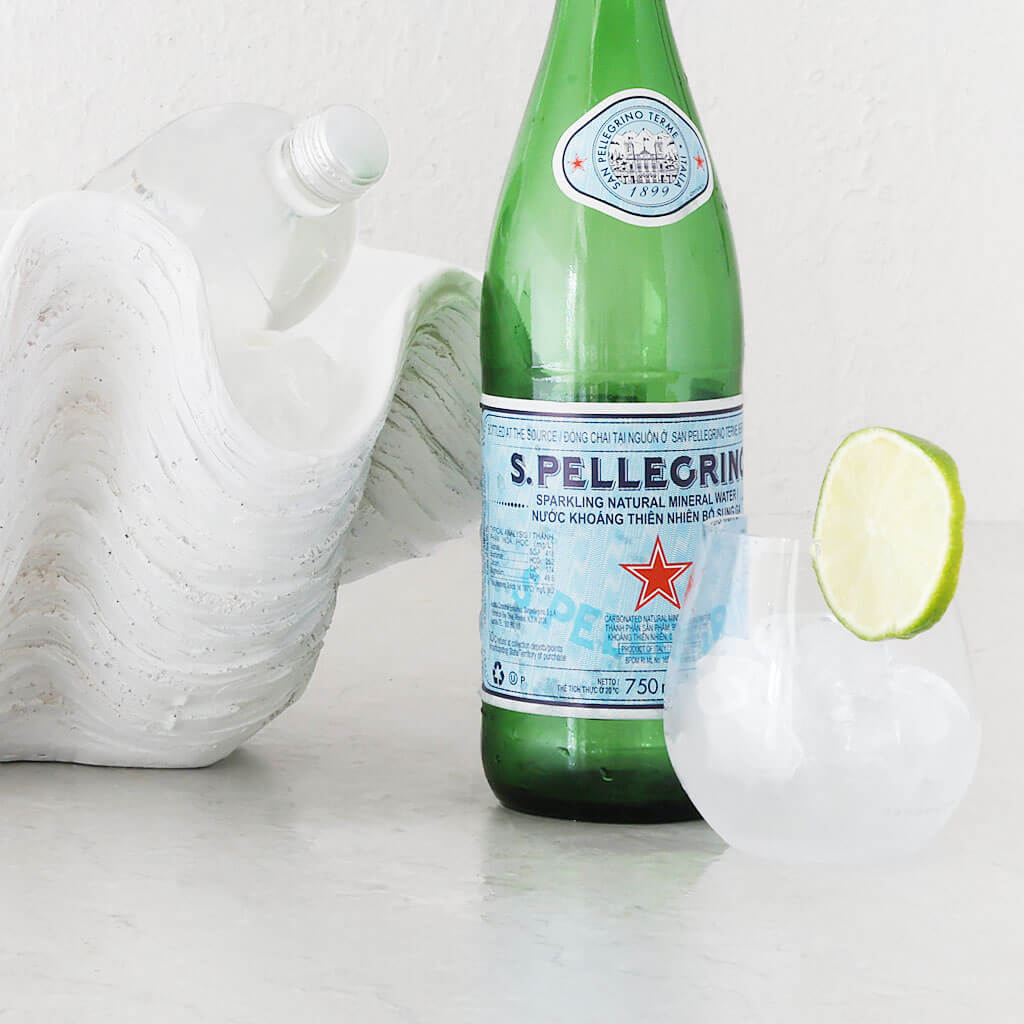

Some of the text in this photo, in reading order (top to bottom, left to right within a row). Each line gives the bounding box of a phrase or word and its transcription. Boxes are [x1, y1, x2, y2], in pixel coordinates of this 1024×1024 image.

[598, 110, 688, 190] SAN PELLEGRINO TERME ITALIA
[630, 185, 670, 197] 1899
[527, 428, 557, 443] SOURCE
[672, 431, 687, 444] SAN
[688, 427, 725, 442] PELLEGRINO
[536, 494, 604, 508] SPARKLING
[608, 496, 665, 509] NATURAL
[668, 493, 713, 508] MINERAL
[714, 489, 736, 504] WATER
[532, 508, 565, 523] NƯỚC
[569, 510, 624, 525] KHOÁNG
[627, 511, 663, 525] THIÊN
[667, 509, 699, 524] NHIÊN
[605, 614, 642, 624] CARBONATED
[643, 614, 666, 623] NATURAL
[597, 678, 616, 686] NETTO
[625, 677, 659, 695] 750
